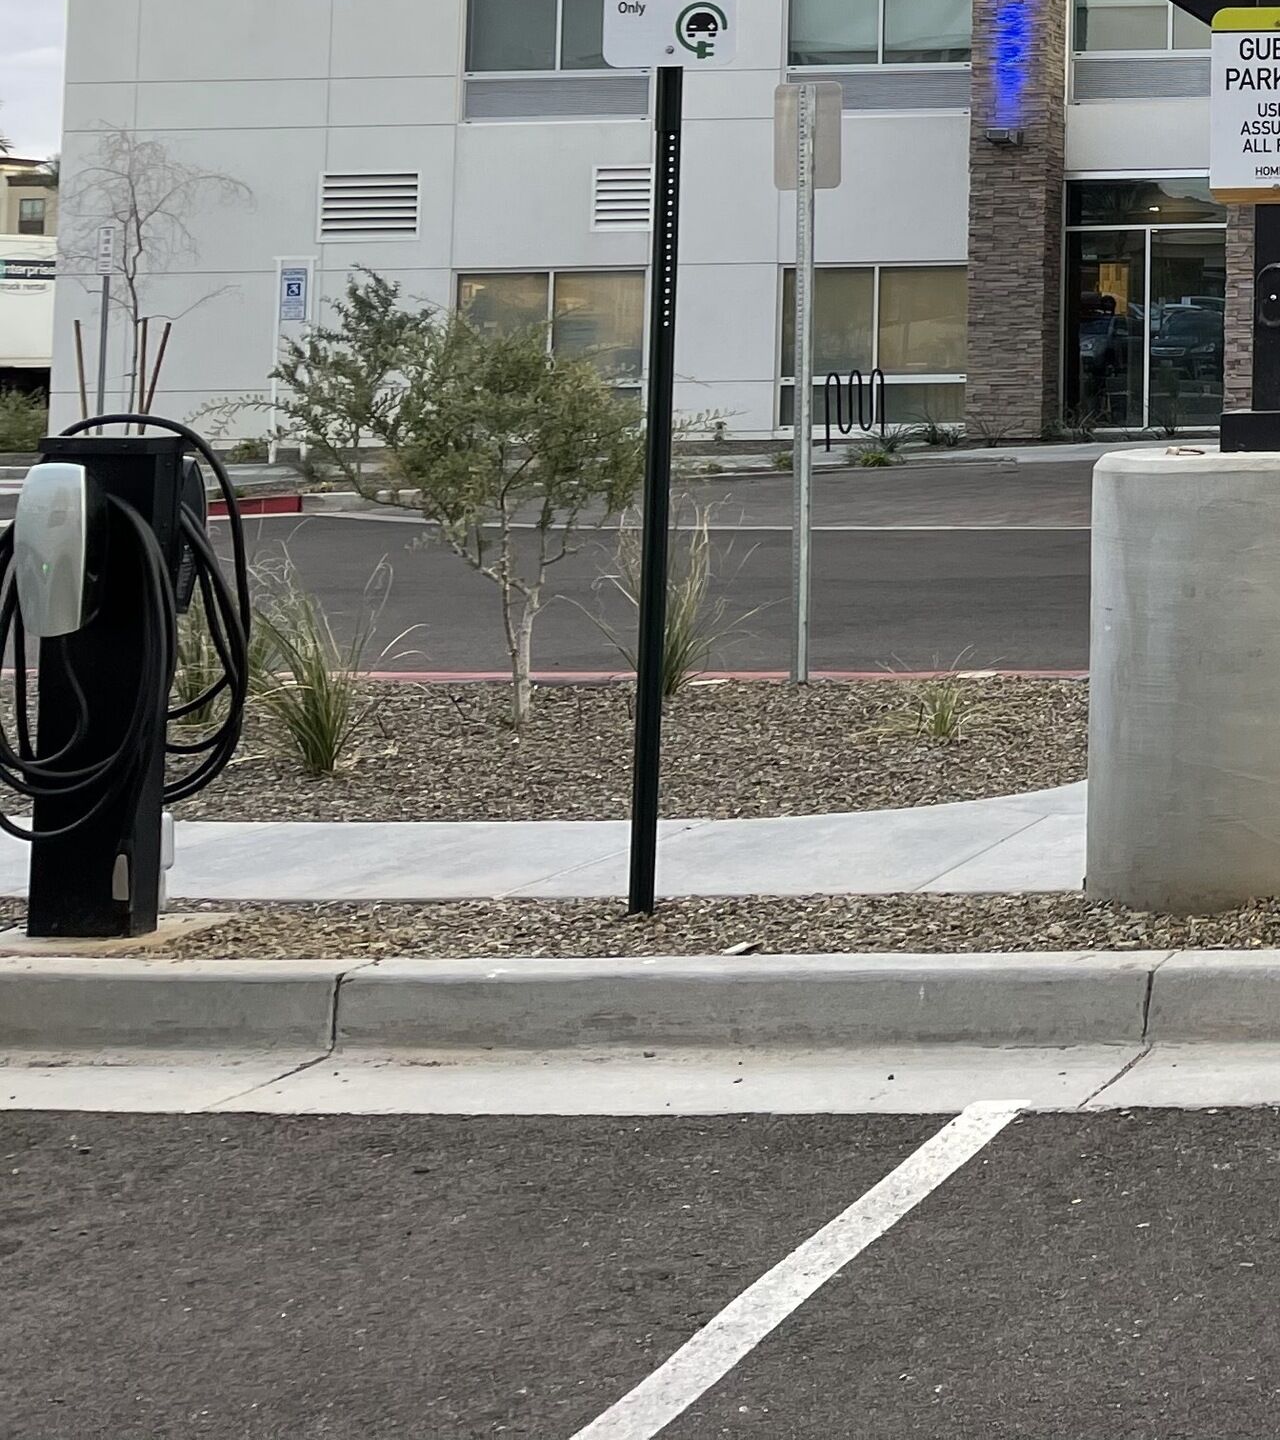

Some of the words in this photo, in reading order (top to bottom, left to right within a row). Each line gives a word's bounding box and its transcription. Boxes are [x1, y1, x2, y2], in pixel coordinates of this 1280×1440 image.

[618, 2, 646, 16] Only
[1242, 138, 1272, 153] ALL
[0, 263, 56, 277] nterprise
